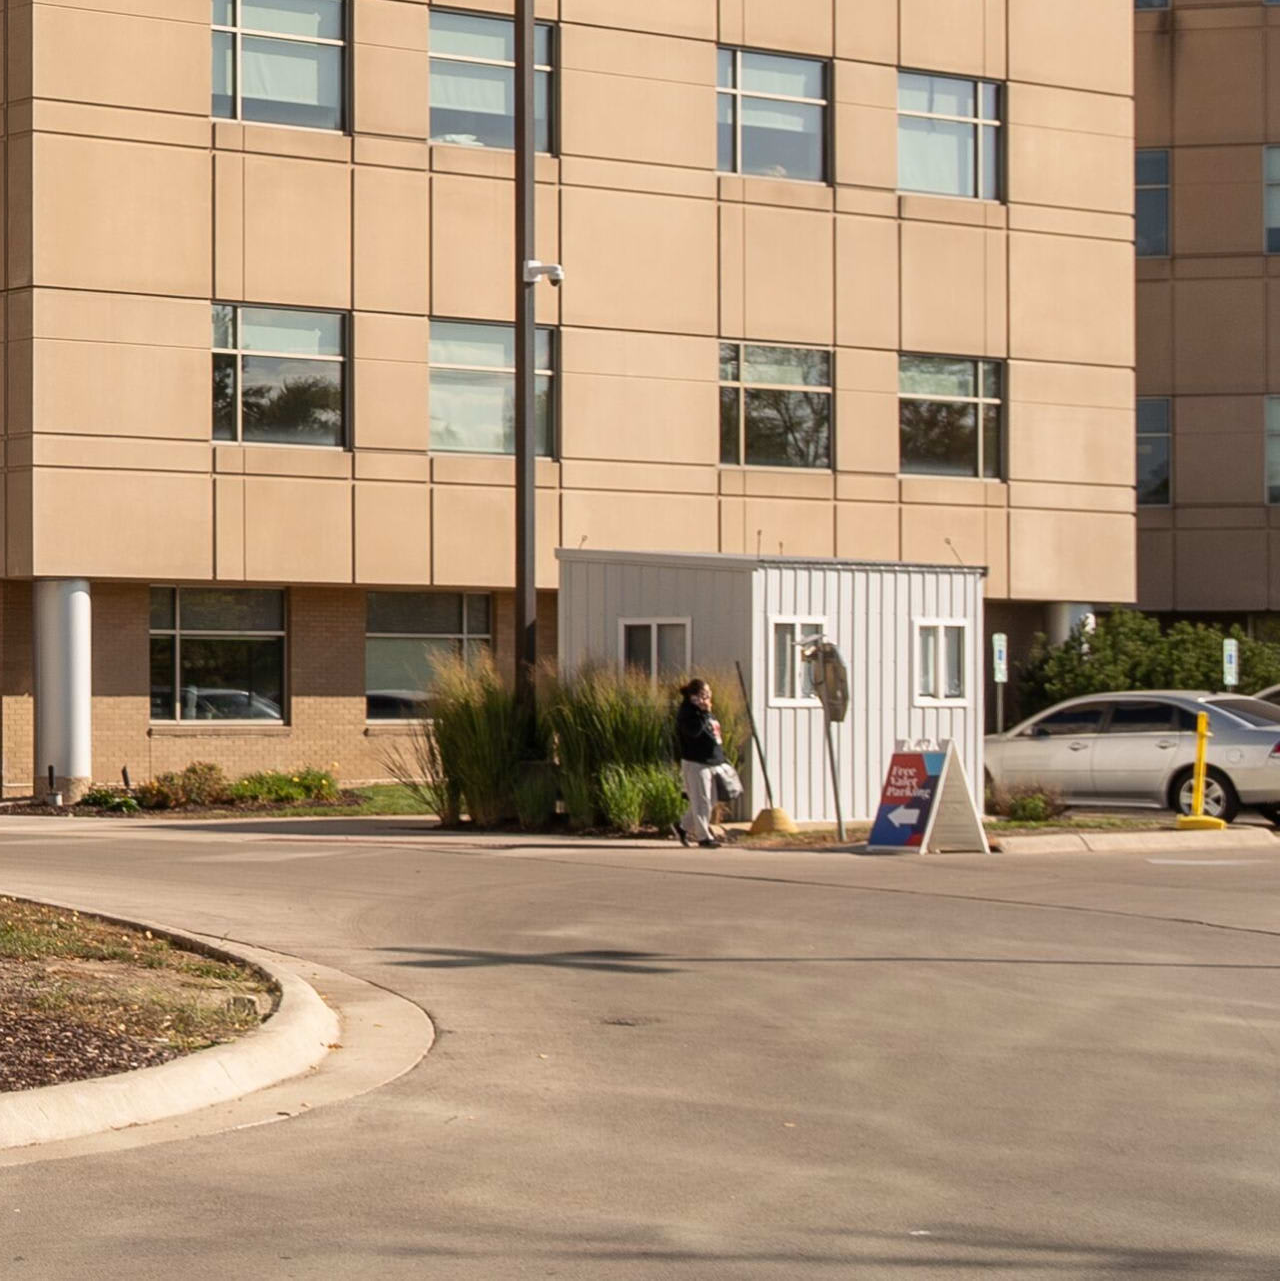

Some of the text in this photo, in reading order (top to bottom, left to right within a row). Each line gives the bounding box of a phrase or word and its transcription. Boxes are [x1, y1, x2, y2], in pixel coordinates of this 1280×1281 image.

[891, 766, 917, 776] Free
[890, 775, 919, 787] Valet
[886, 785, 931, 800] Parking
